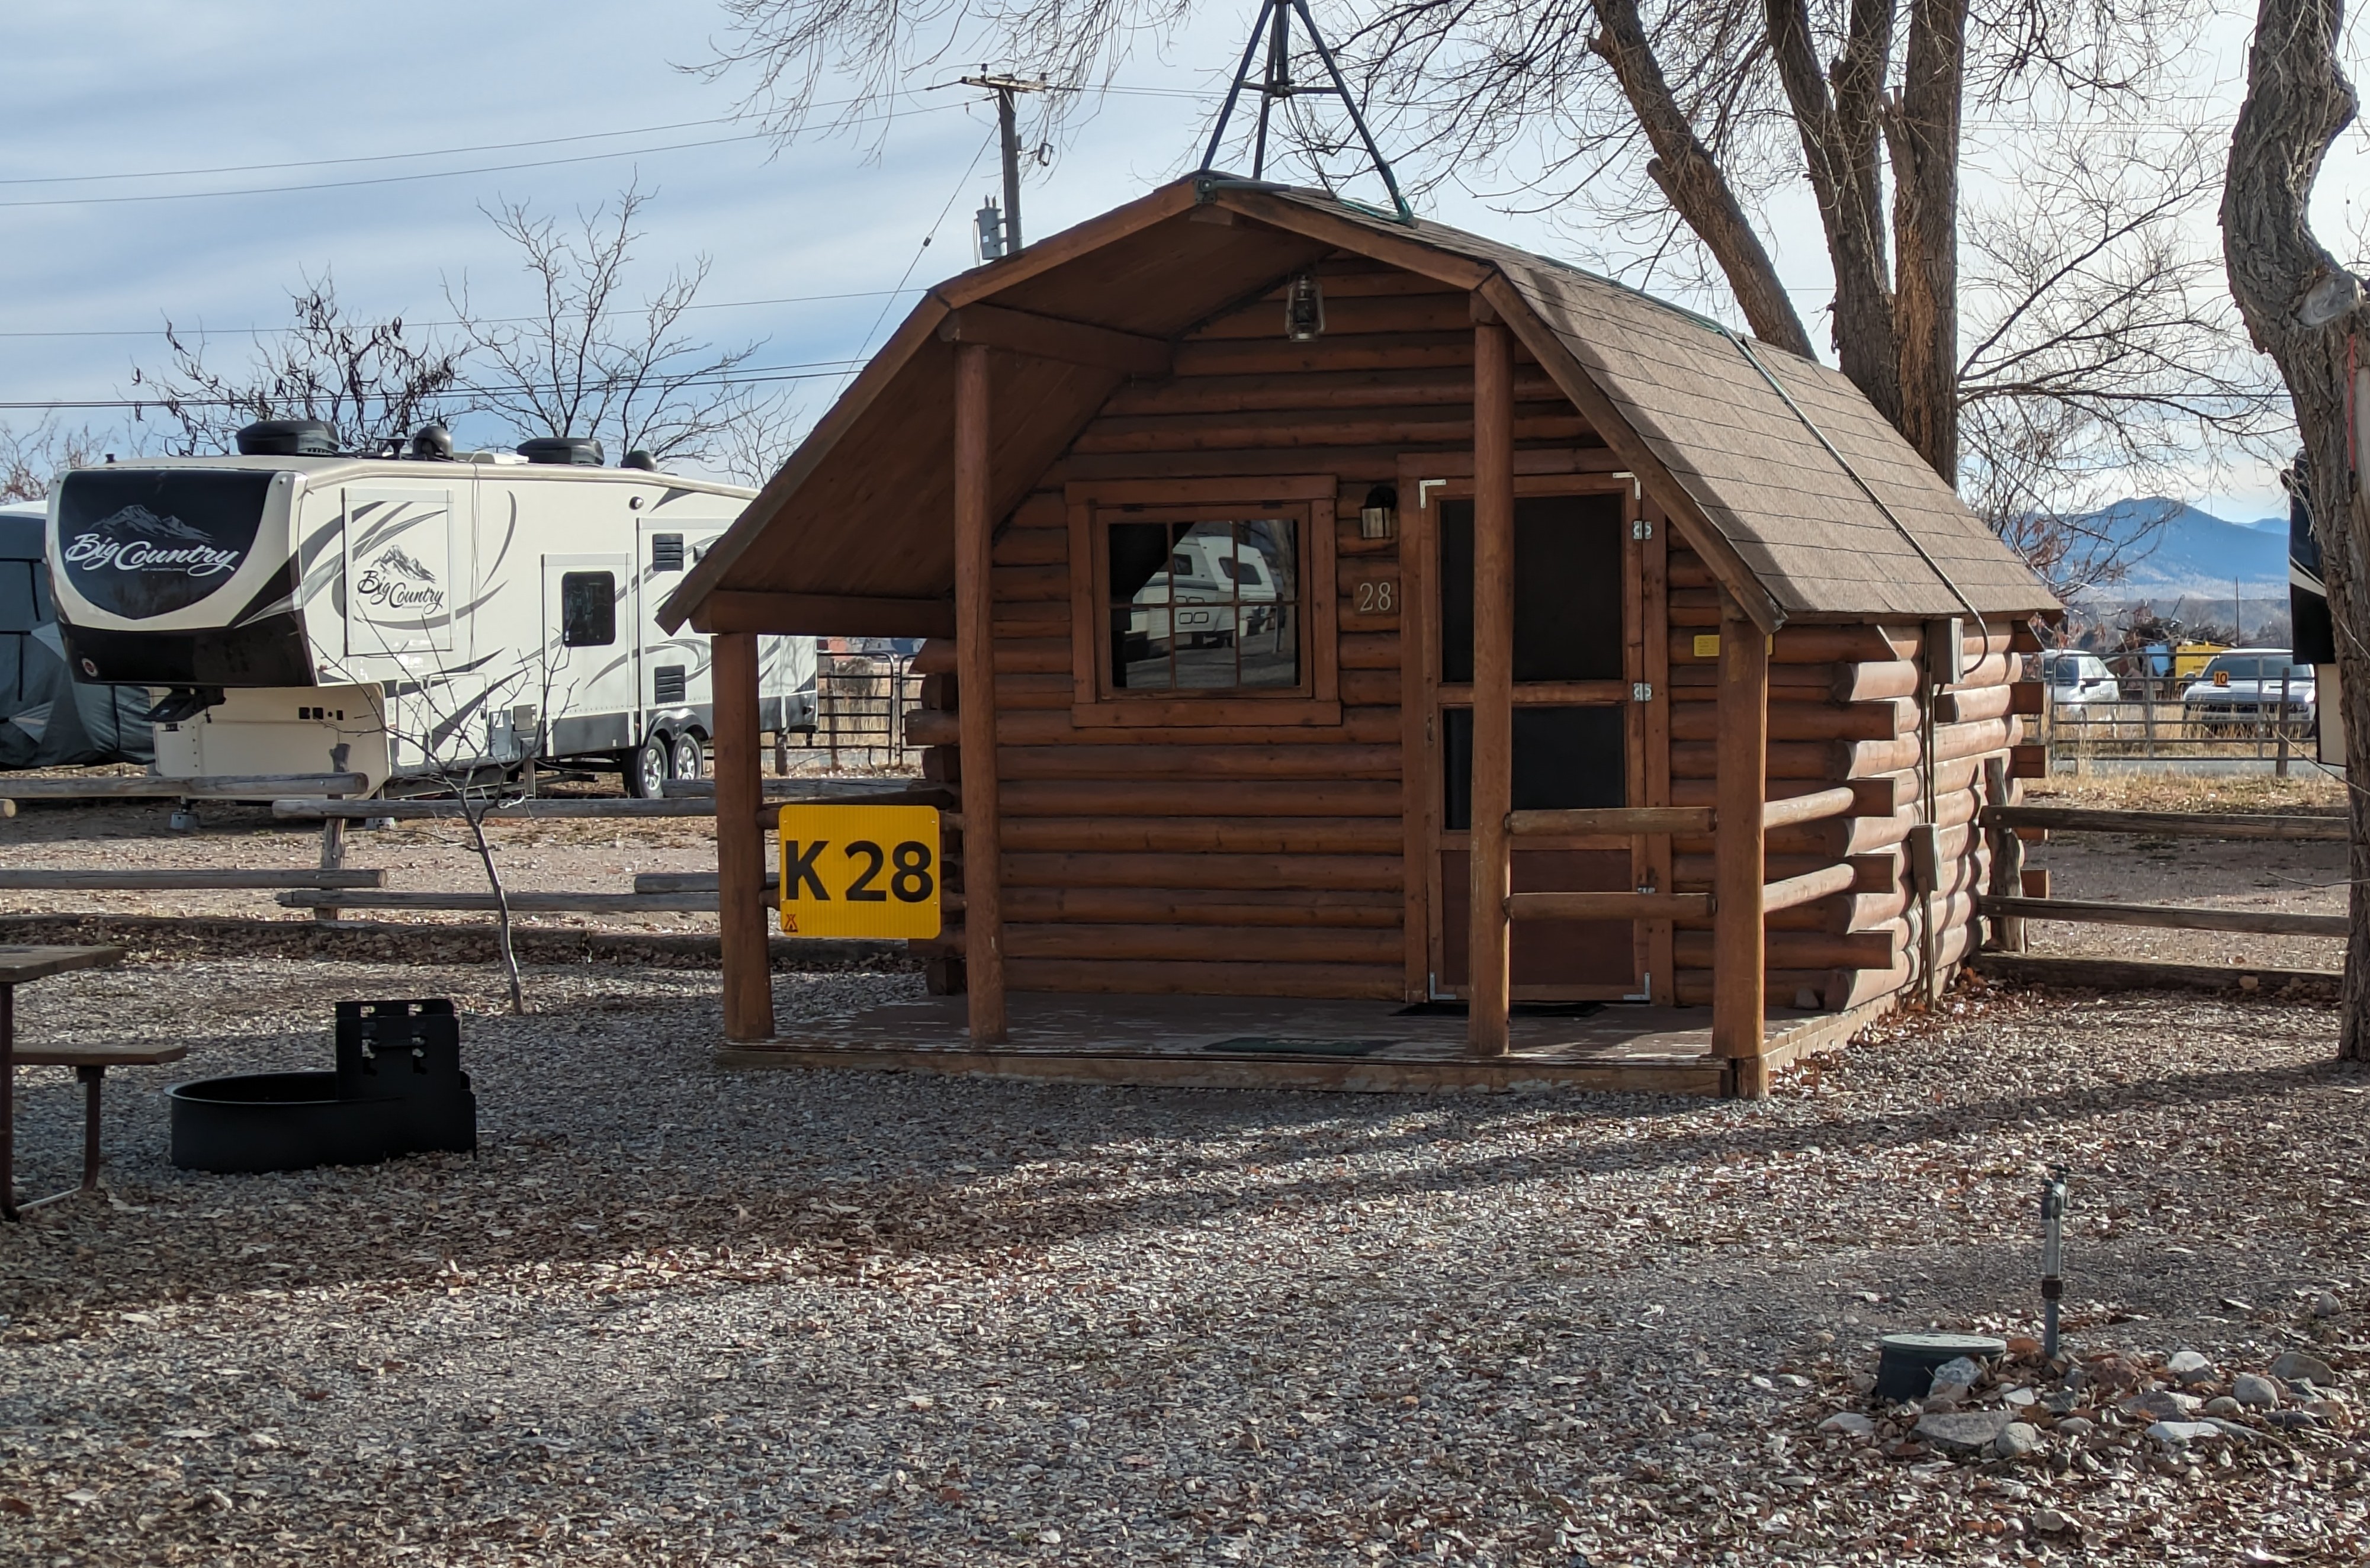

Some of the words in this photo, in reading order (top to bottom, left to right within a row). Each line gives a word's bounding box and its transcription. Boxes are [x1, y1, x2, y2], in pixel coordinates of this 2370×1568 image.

[65, 533, 120, 570] Big
[114, 541, 239, 577] Country
[357, 570, 391, 605] Big
[388, 582, 444, 615] Country
[1359, 582, 1391, 611] 28
[2215, 673, 2227, 684] 10
[785, 840, 831, 901] K
[844, 840, 934, 903] 28
